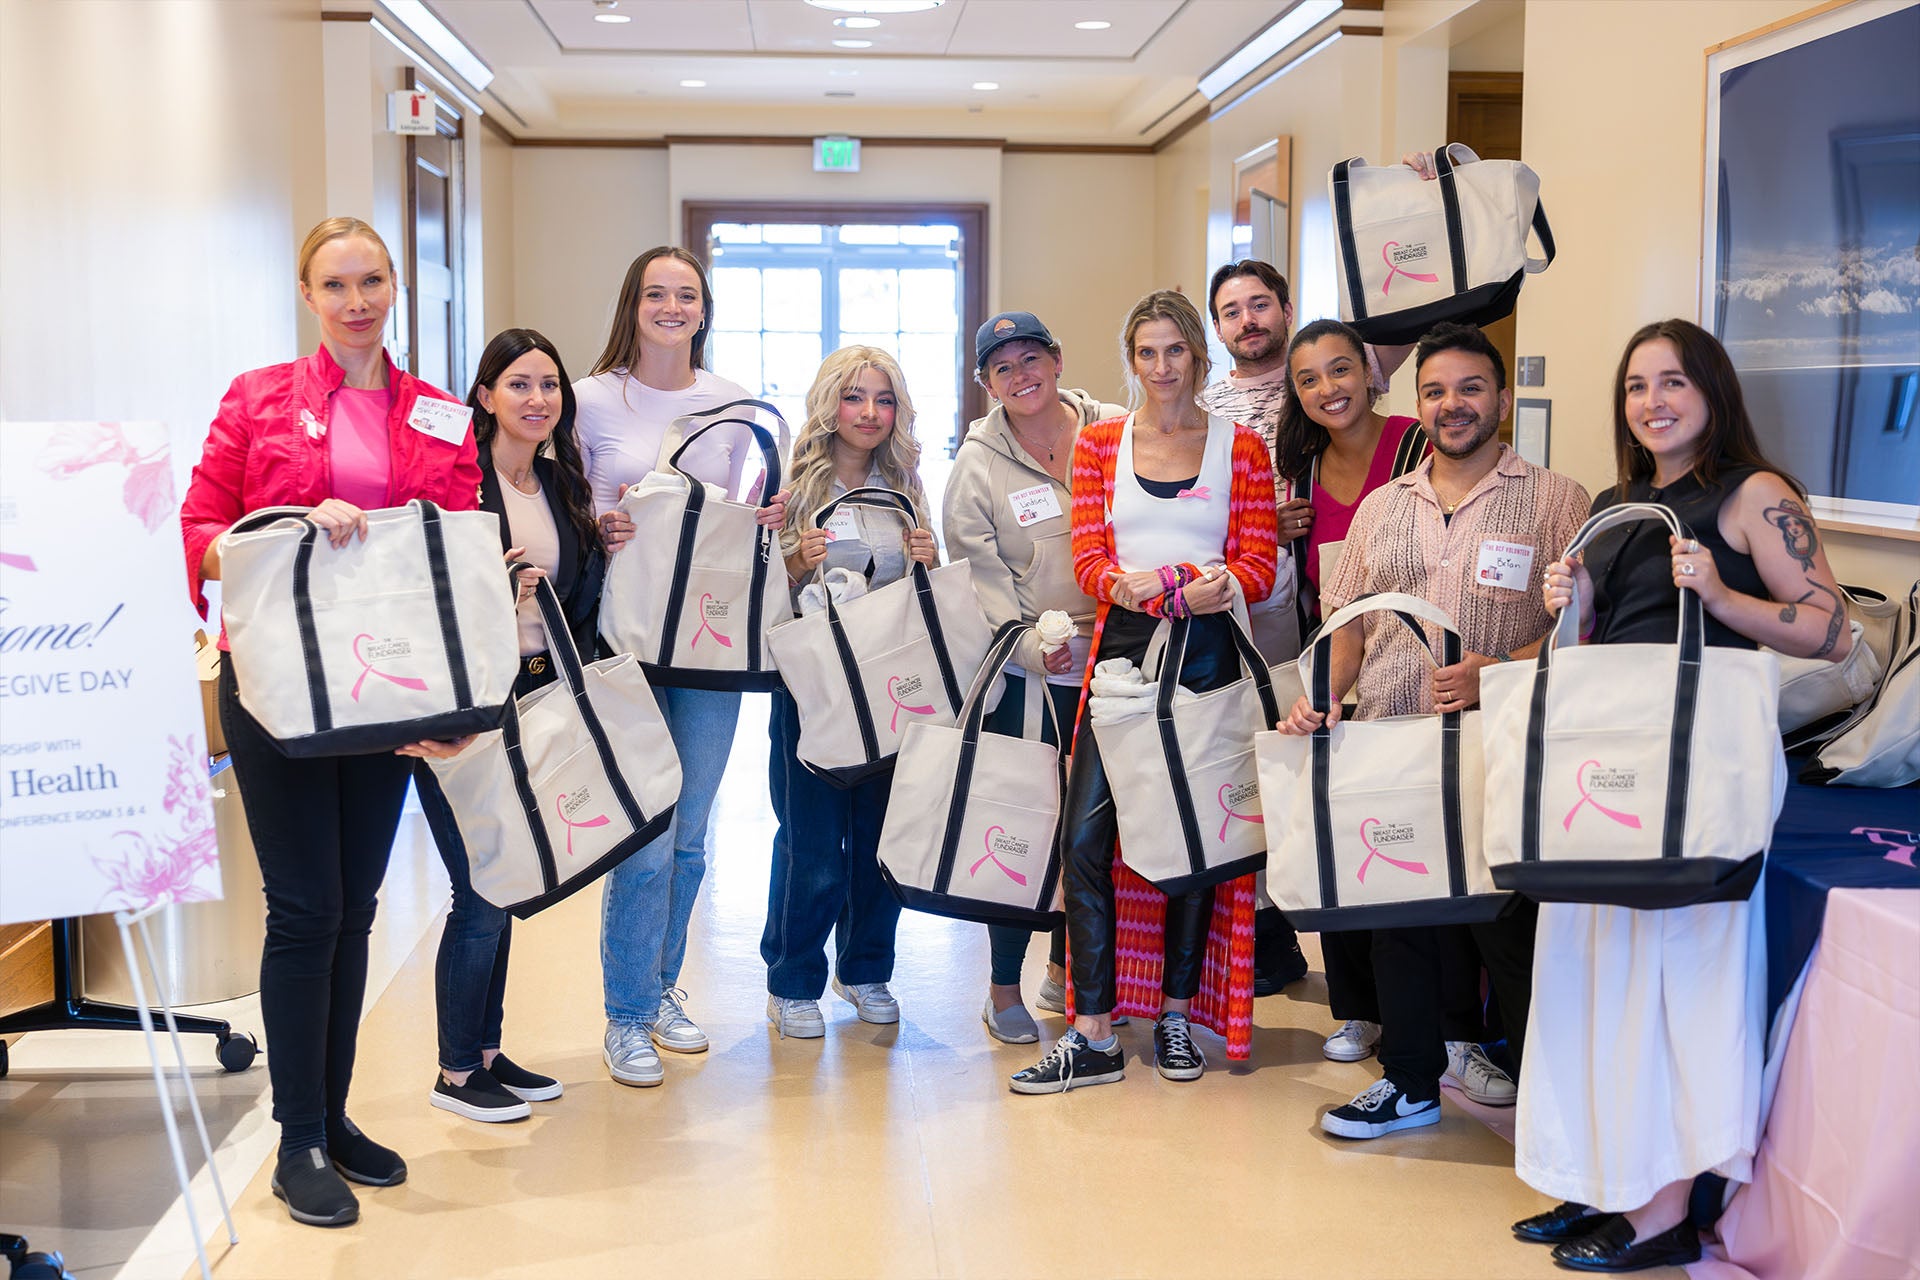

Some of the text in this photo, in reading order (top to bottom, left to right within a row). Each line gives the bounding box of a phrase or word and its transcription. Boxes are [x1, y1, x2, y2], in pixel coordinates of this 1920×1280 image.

[822, 141, 853, 168] EXIT
[1394, 250, 1428, 261] FUNDRAISER
[1506, 547, 1530, 557] VOLUNTEER
[0, 597, 124, 653] ome!
[368, 648, 411, 659] FUNDRAISER
[80, 668, 133, 692] DAY
[907, 677, 921, 686] CANCER
[897, 681, 922, 696] FUNDRAISER
[45, 739, 81, 753] WITH
[10, 763, 119, 798] Health
[1590, 780, 1635, 788] FUNDRAISER
[1228, 784, 1257, 798] BREAST CANCER
[1229, 789, 1258, 805] FUNDRAISER
[1373, 832, 1415, 843] FUNDRAISER
[993, 842, 1028, 854] FUNDRAISER
